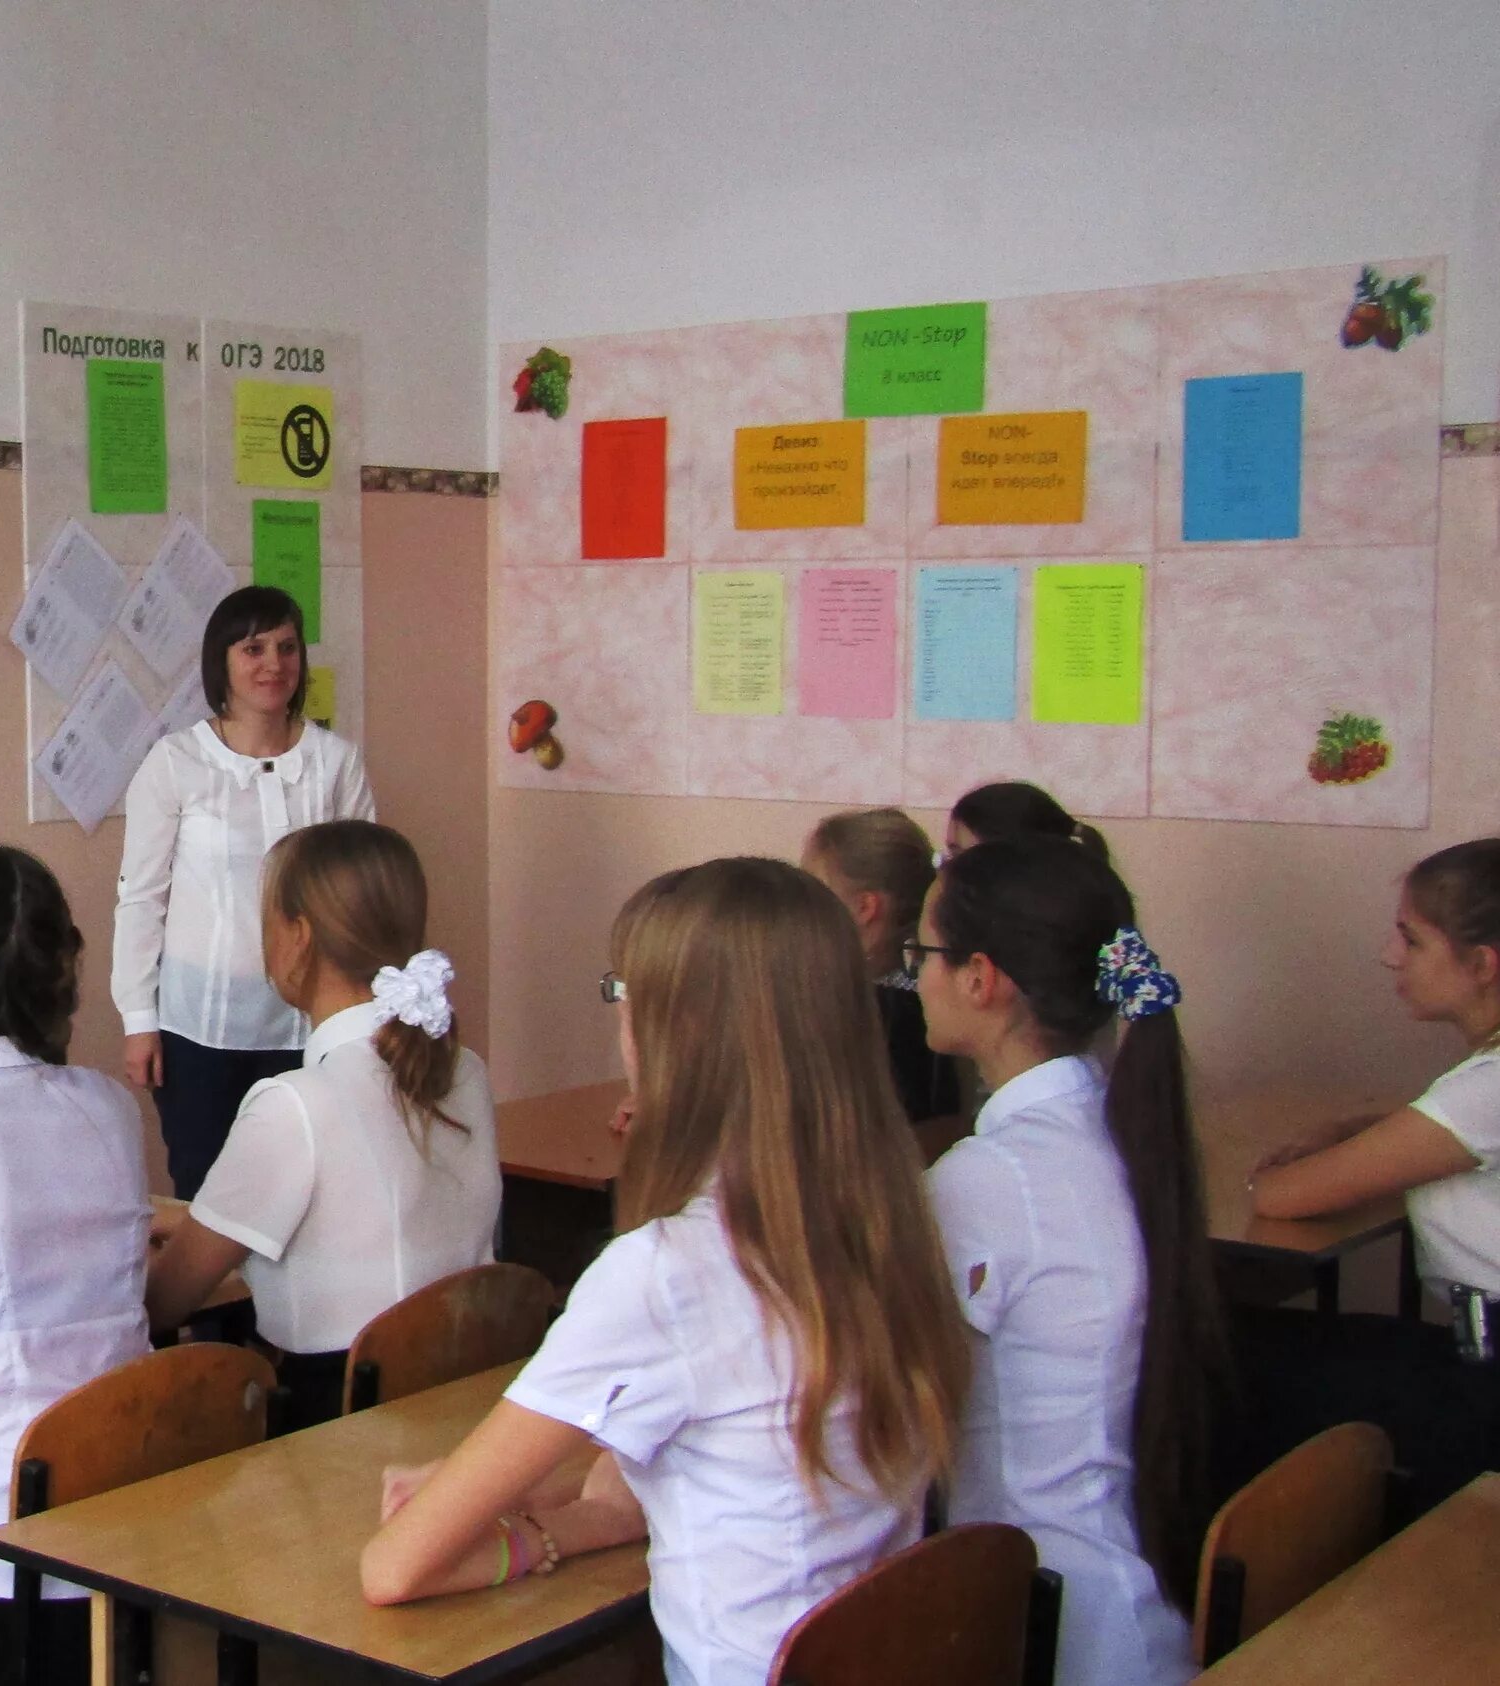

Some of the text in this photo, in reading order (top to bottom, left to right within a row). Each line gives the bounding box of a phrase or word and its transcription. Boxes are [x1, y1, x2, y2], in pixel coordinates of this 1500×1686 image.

[43, 327, 325, 373] Подготовка к ОГЭ 2018
[897, 369, 941, 384] класс
[824, 459, 848, 472] что
[961, 450, 1058, 468] Stop всегда
[951, 477, 986, 490] идет
